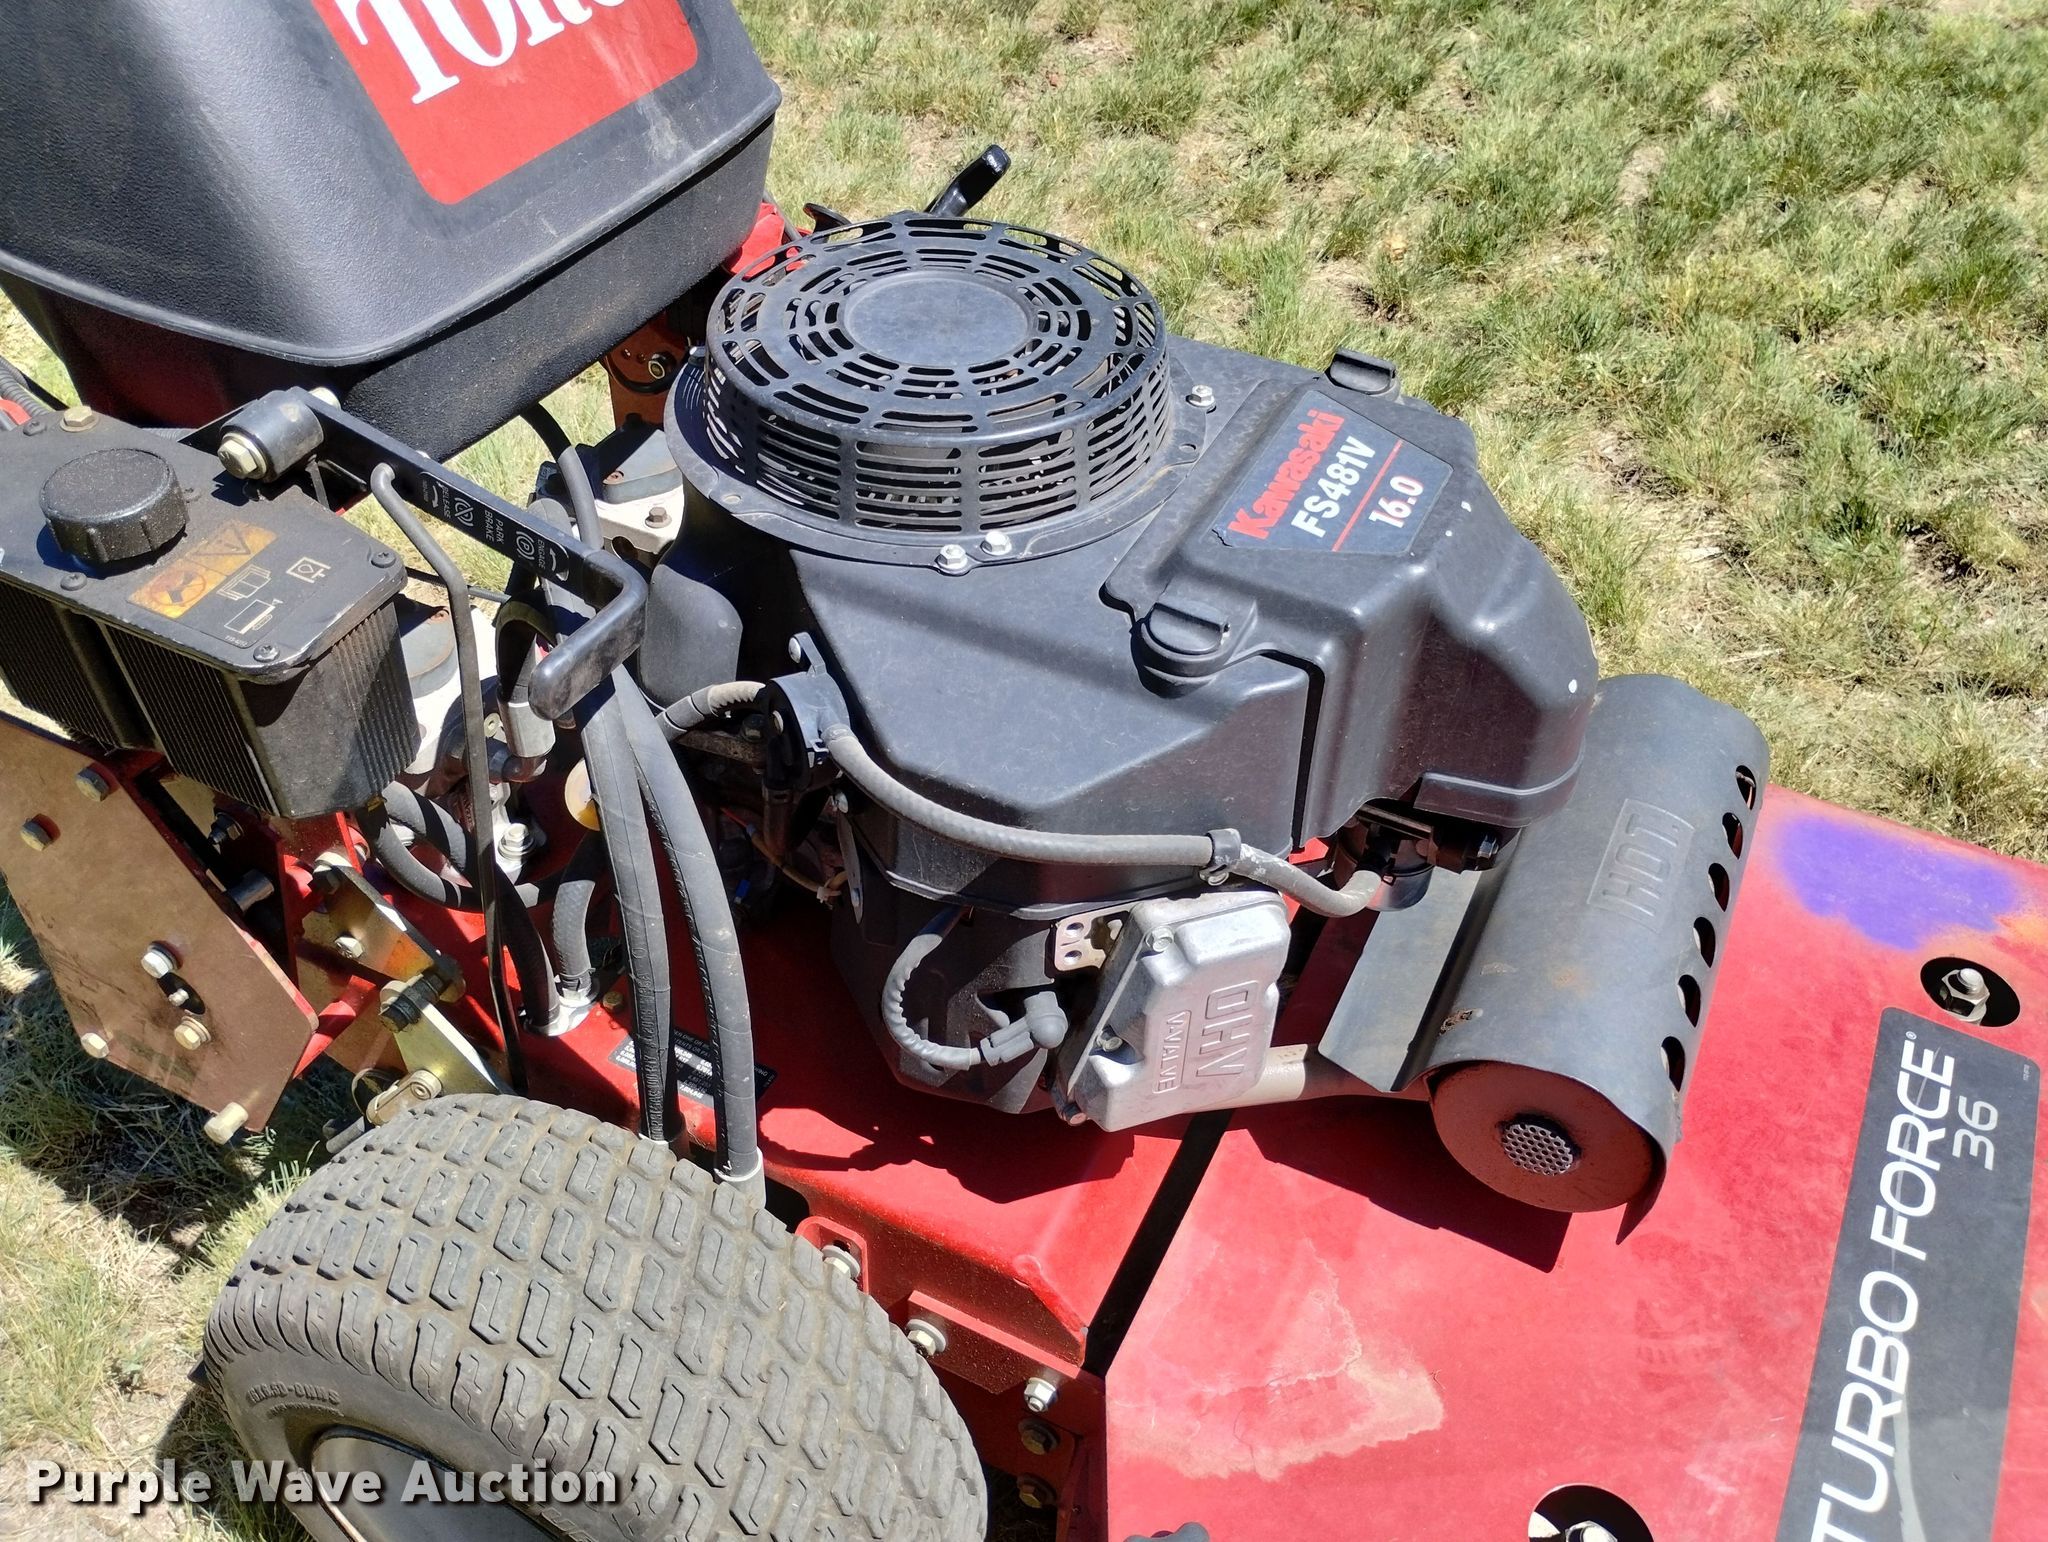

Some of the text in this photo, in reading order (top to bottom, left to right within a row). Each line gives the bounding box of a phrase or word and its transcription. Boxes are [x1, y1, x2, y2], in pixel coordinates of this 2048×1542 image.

[1228, 408, 1345, 540] Kawasaki
[1291, 435, 1376, 538] FS481V
[1369, 475, 1424, 528] 16.0
[484, 509, 495, 543] BRAKE
[495, 516, 505, 545] PARK
[537, 538, 547, 570] ENGAGE
[1601, 812, 1681, 918] HOT
[1196, 980, 1259, 1077] OHV
[1951, 1095, 1999, 1171] 36
[1811, 1269, 1919, 1542] TURBO
